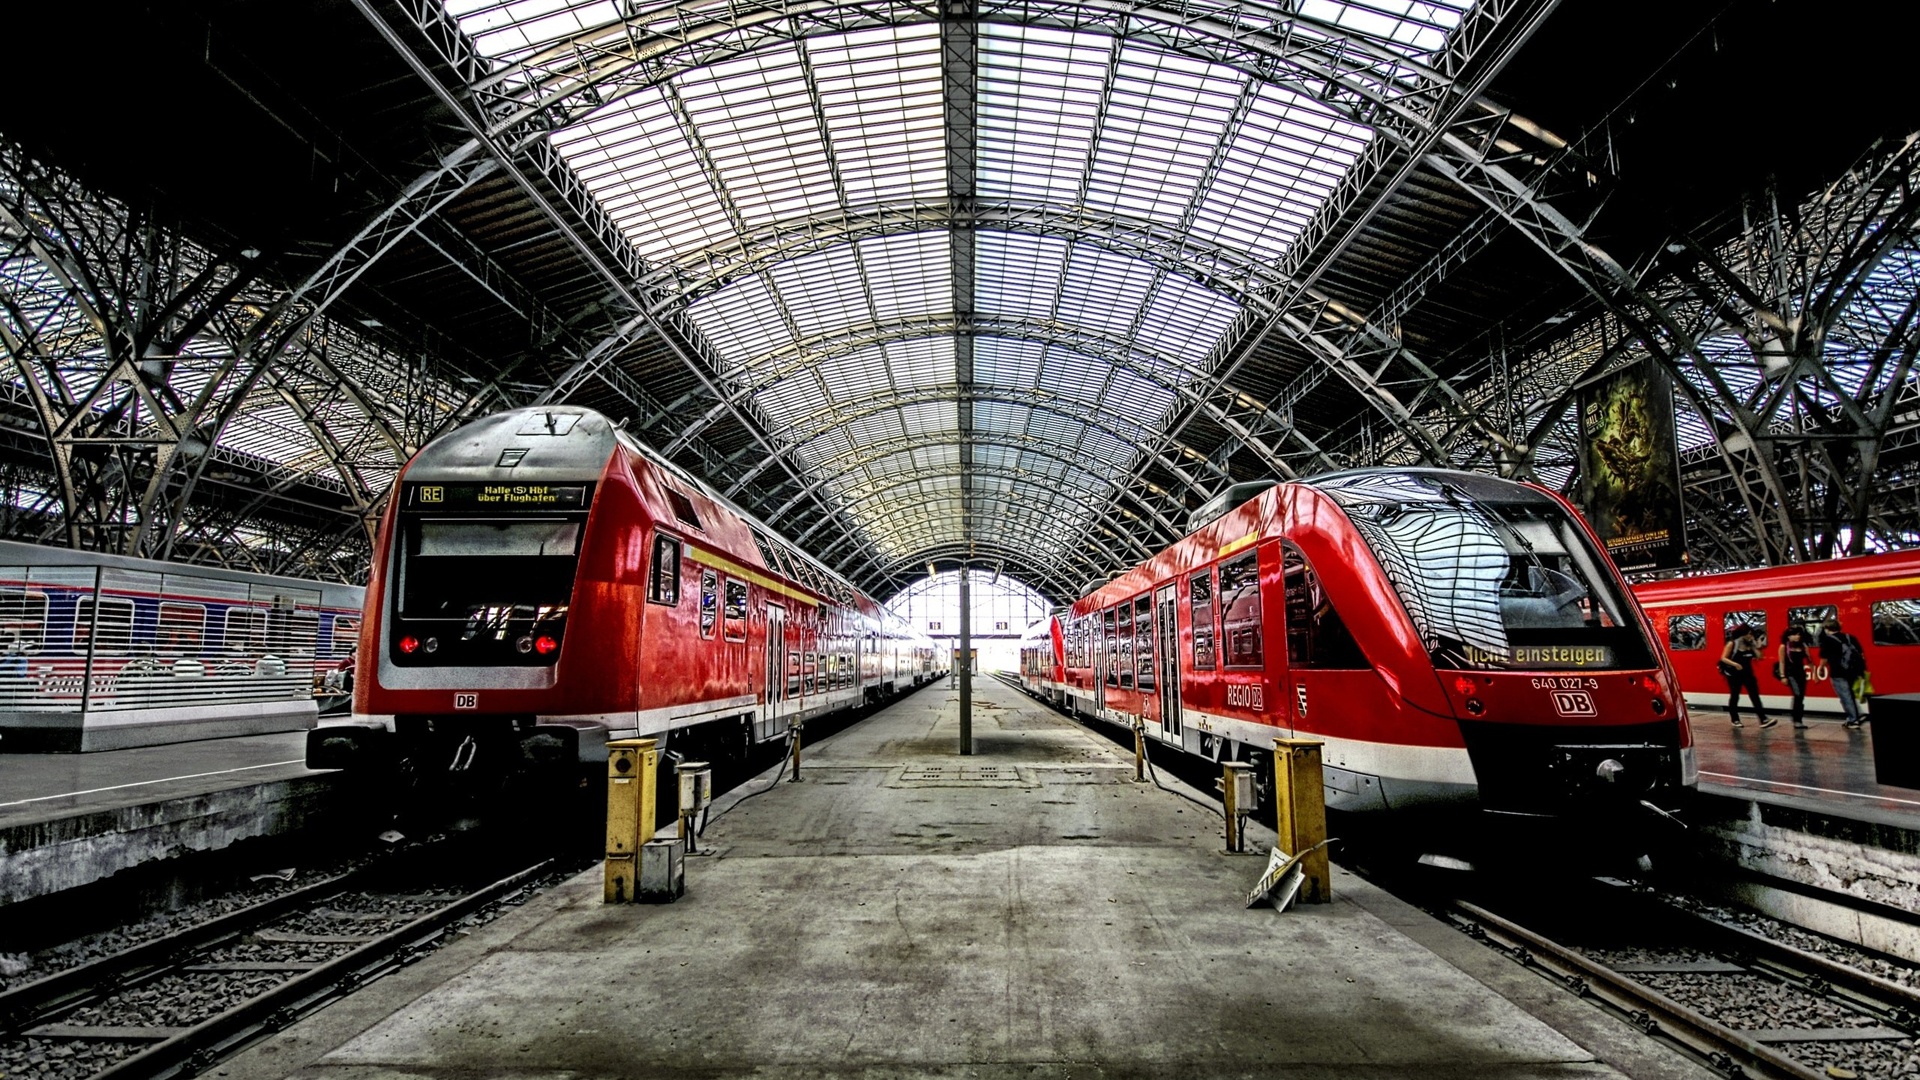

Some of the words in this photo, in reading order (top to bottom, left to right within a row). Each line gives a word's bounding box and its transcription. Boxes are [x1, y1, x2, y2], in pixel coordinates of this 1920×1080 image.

[423, 488, 441, 501] RE
[484, 486, 511, 495] Halle
[513, 486, 527, 495] (S)
[529, 486, 548, 495] Hbf
[478, 494, 500, 502] über
[504, 494, 555, 503] Flughafen
[1644, 529, 1670, 541] ONLINE
[1631, 541, 1670, 551] RECKONING
[1516, 646, 1605, 665] einsteigen
[1803, 664, 1829, 681] GIO
[1531, 678, 1557, 689] 640
[1561, 678, 1599, 689] 027-9
[456, 695, 476, 708] DB
[1227, 684, 1251, 707] REGIO
[1554, 693, 1593, 714] DB
